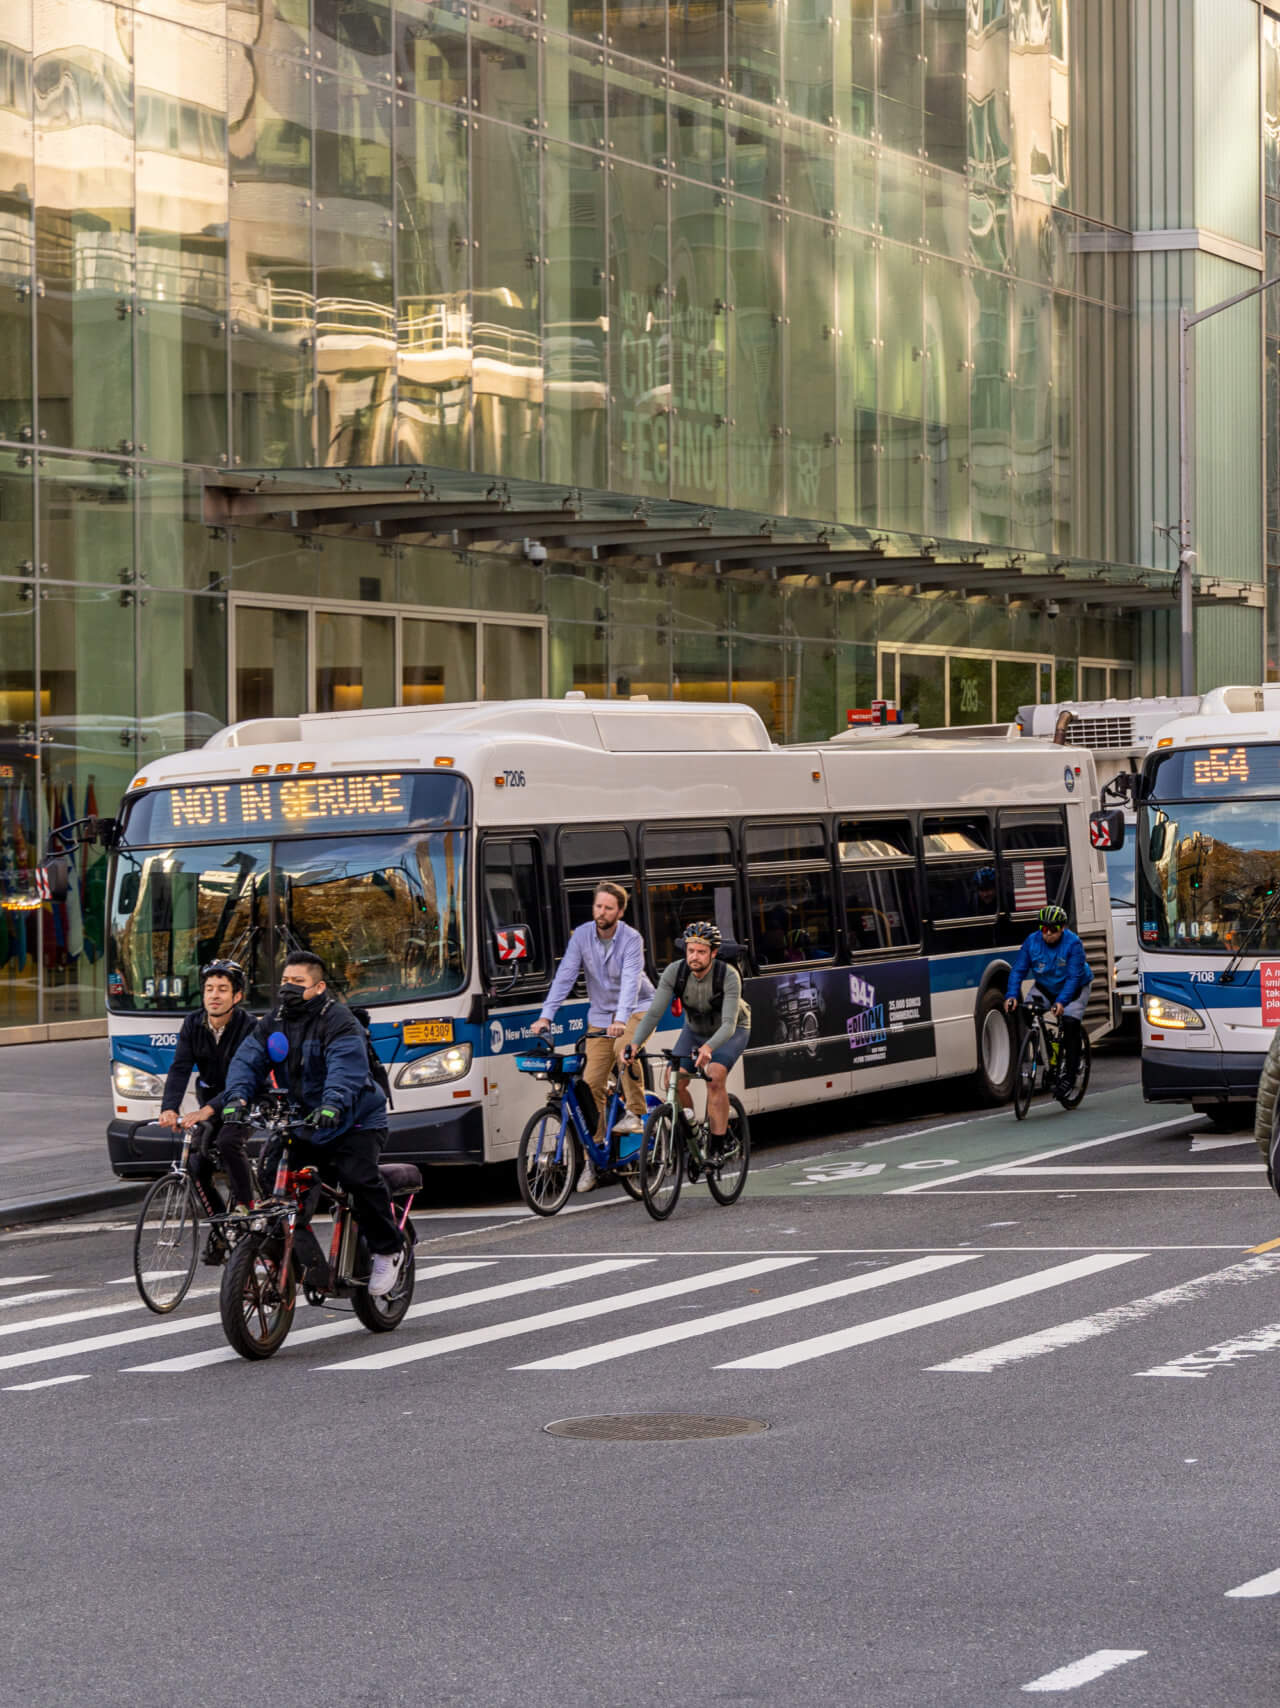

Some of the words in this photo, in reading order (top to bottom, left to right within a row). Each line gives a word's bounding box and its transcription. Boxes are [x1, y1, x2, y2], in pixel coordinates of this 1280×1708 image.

[961, 679, 978, 712] 285
[1194, 748, 1248, 783] B54
[503, 770, 525, 787] 7206
[170, 785, 231, 826] NOT
[240, 783, 272, 822] IN
[279, 774, 404, 820] SERVICE
[1189, 971, 1215, 983] 7108
[1265, 968, 1273, 977] A
[505, 1029, 520, 1041] New
[551, 1023, 564, 1034] Bus
[568, 1018, 584, 1032] 7206
[149, 1034, 177, 1046] 7206
